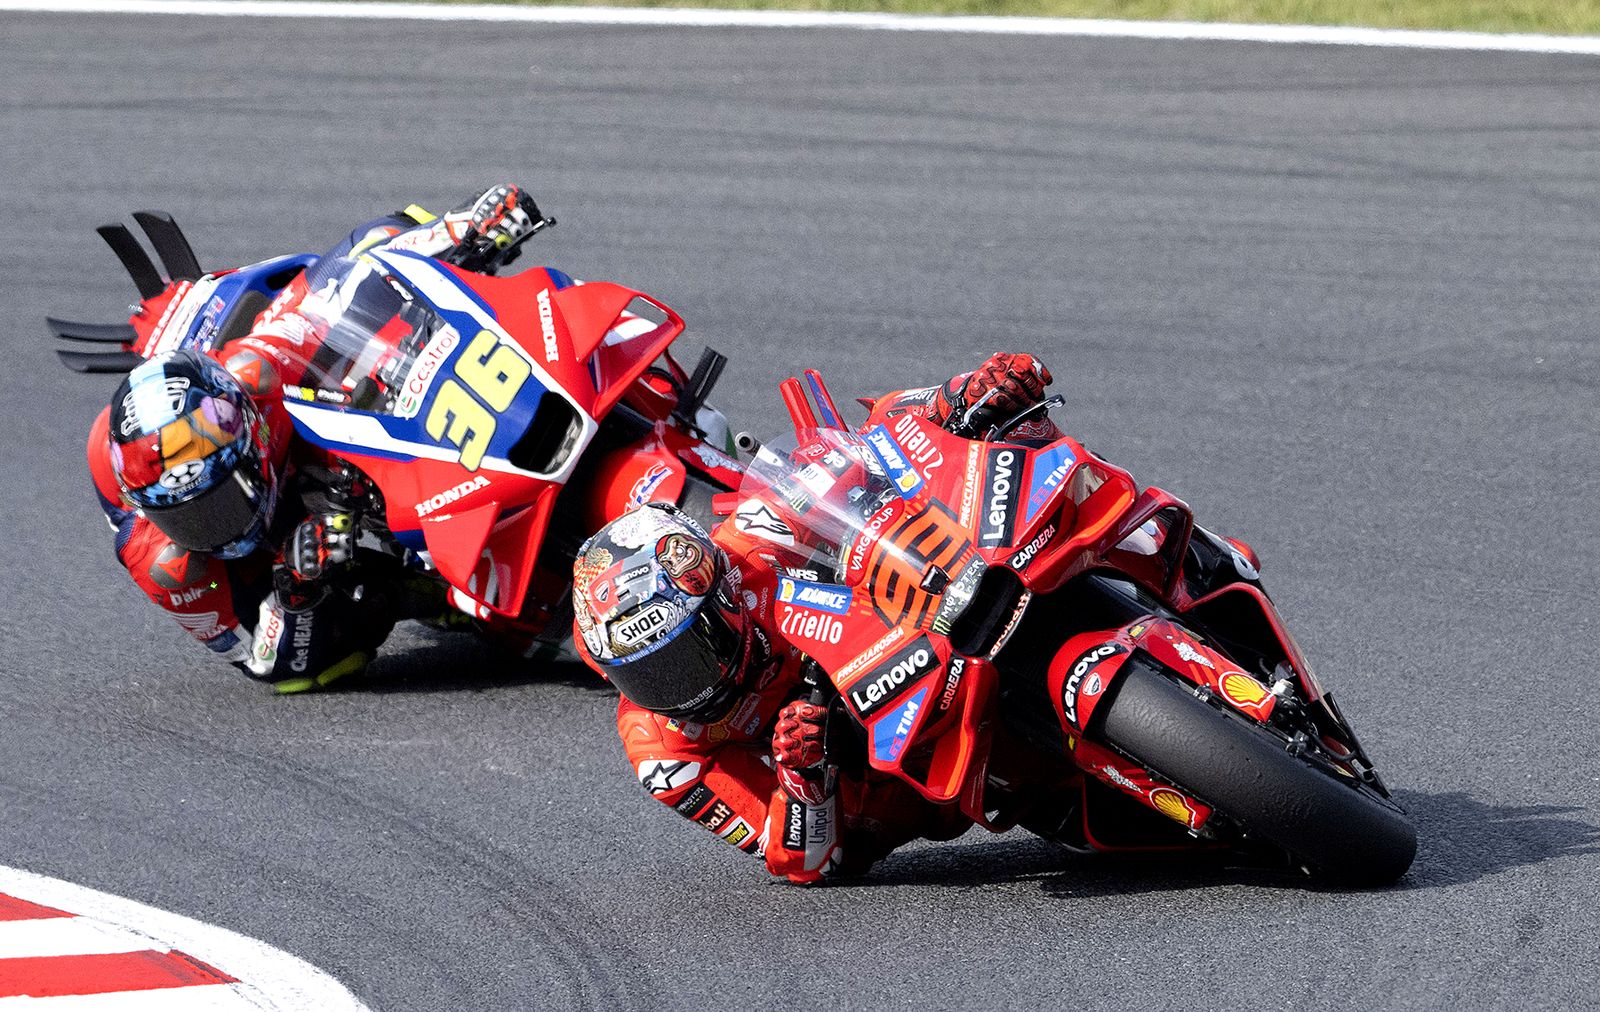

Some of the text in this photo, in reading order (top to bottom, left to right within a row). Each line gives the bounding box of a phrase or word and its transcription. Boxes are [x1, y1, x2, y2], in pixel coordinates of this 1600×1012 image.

[536, 289, 560, 362] HONDA
[409, 331, 456, 395] Castrol
[425, 328, 532, 472] 36
[1044, 457, 1074, 488] TIM
[415, 476, 492, 517] HONDA
[983, 450, 1016, 541] Lenovo
[1011, 525, 1056, 570] CARRERA
[786, 567, 819, 581] WRS
[621, 609, 664, 642] SHOEI
[678, 685, 714, 711] insta360
[852, 648, 929, 712] Lenovo
[940, 658, 965, 711] CARRERA
[1064, 645, 1116, 723] Lenovo
[896, 700, 919, 737] TIM
[786, 803, 802, 848] Lenovo
[808, 807, 828, 846] Unipol
